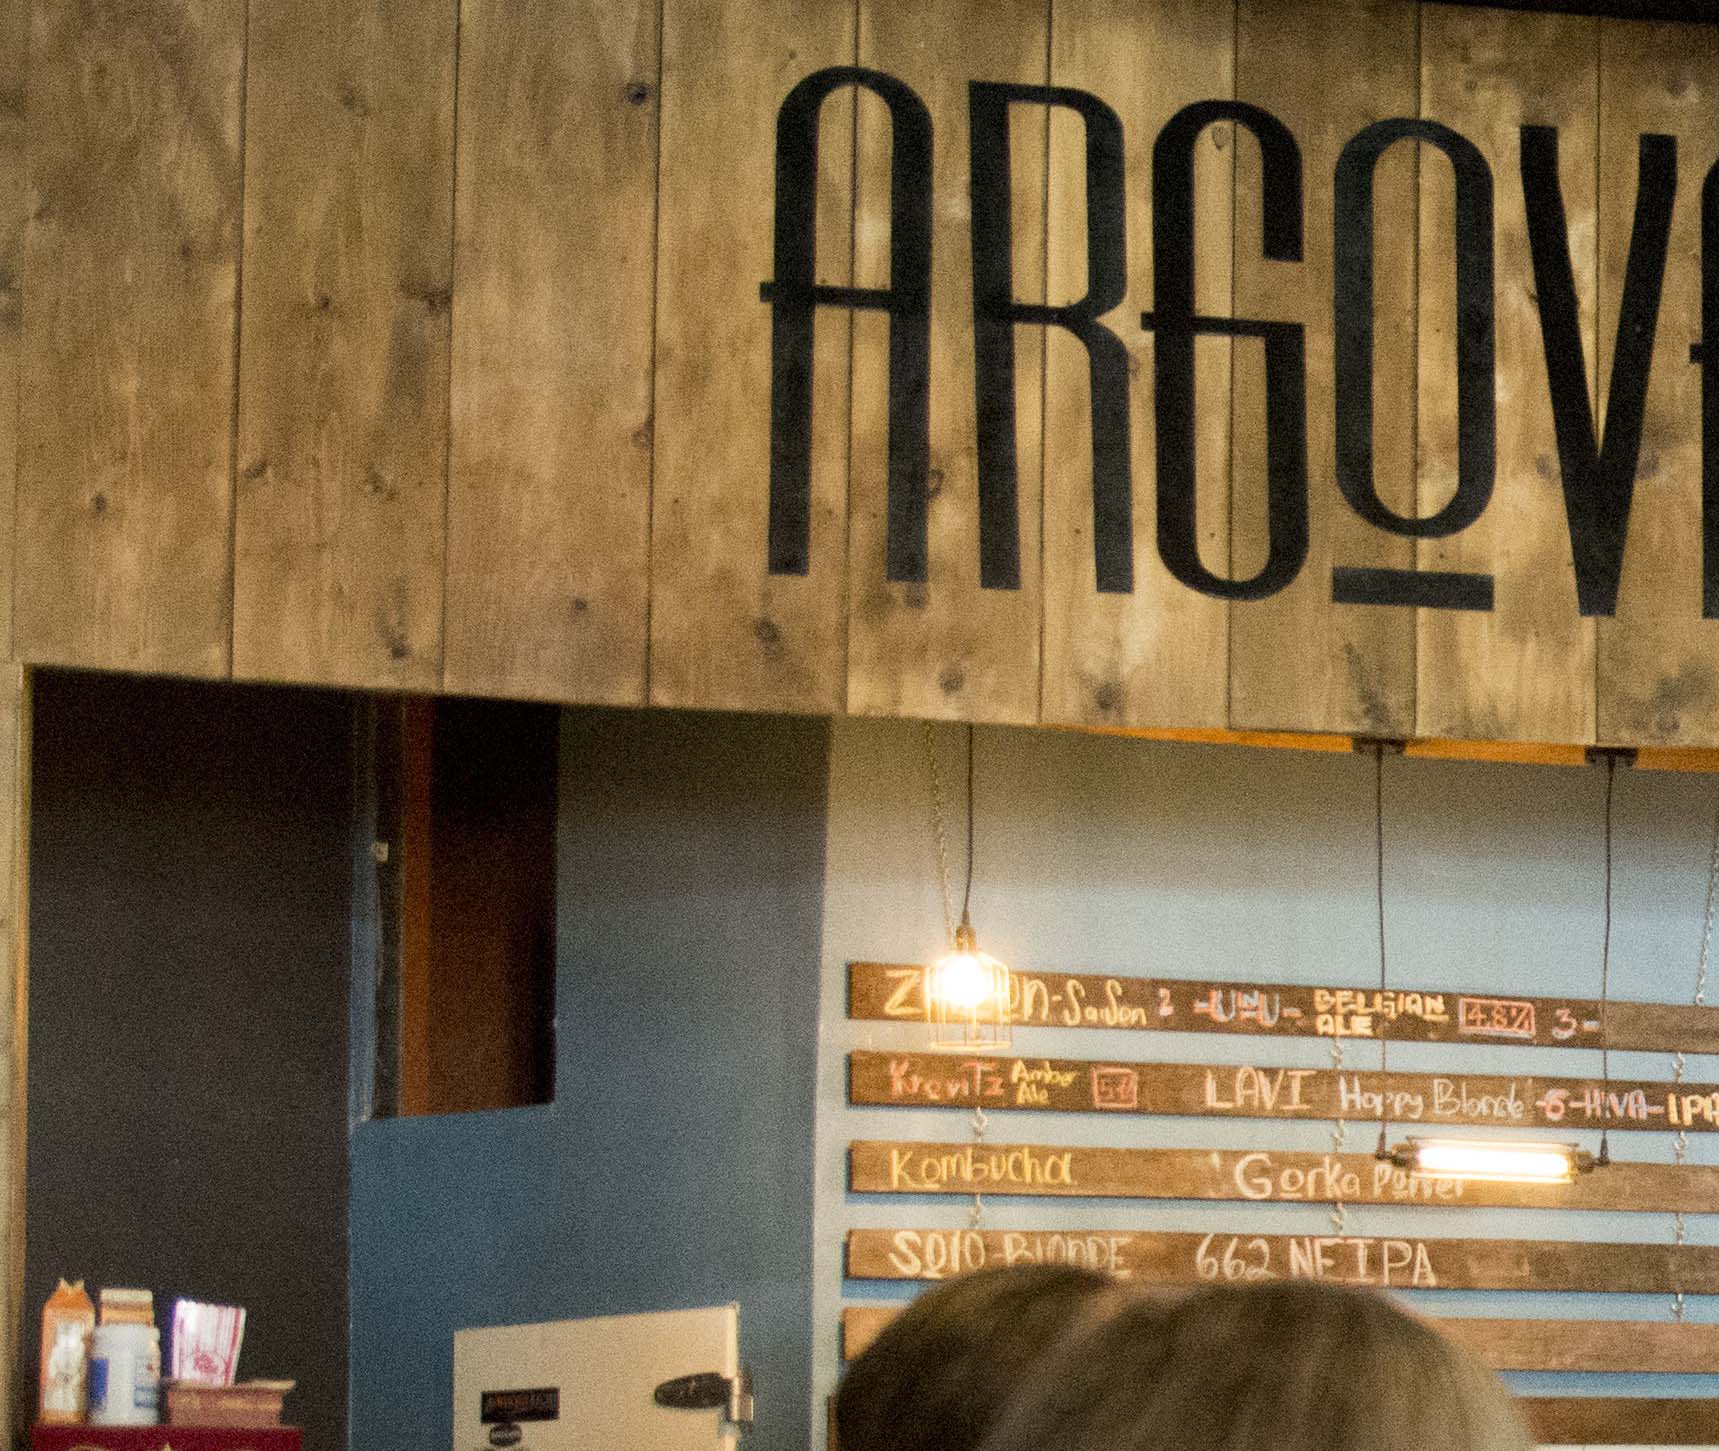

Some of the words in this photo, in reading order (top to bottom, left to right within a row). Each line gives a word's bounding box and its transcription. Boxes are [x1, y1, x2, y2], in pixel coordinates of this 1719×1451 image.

[1314, 988, 1449, 1021] BELGIAN
[1315, 1013, 1373, 1036] ALE
[1235, 1153, 1359, 1200] Gorka
[1196, 1233, 1277, 1281] 662
